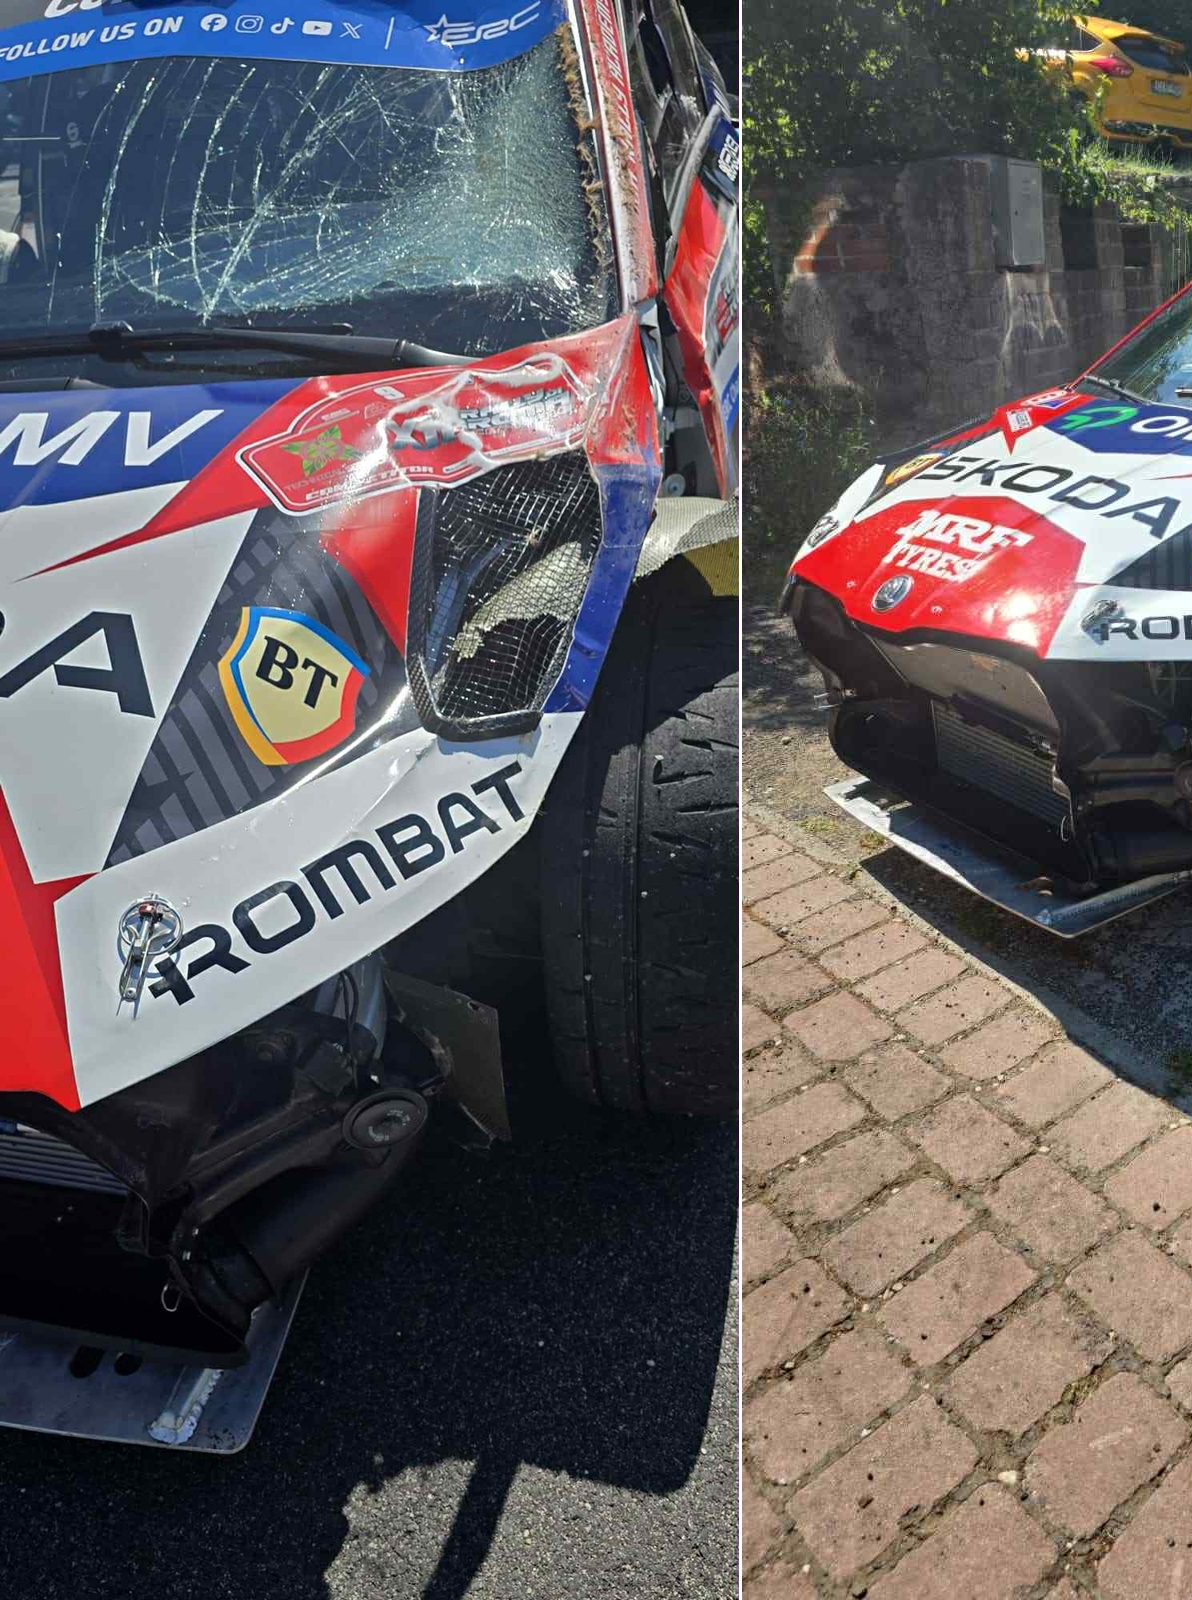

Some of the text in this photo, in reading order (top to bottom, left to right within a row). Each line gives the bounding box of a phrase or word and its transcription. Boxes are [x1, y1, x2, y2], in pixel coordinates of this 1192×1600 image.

[101, 22, 137, 43] US
[143, 15, 184, 37] ON
[894, 510, 1035, 550] MRF
[883, 543, 986, 583] TYRES
[255, 634, 339, 710] BT
[148, 762, 530, 1007] ROMBAT
